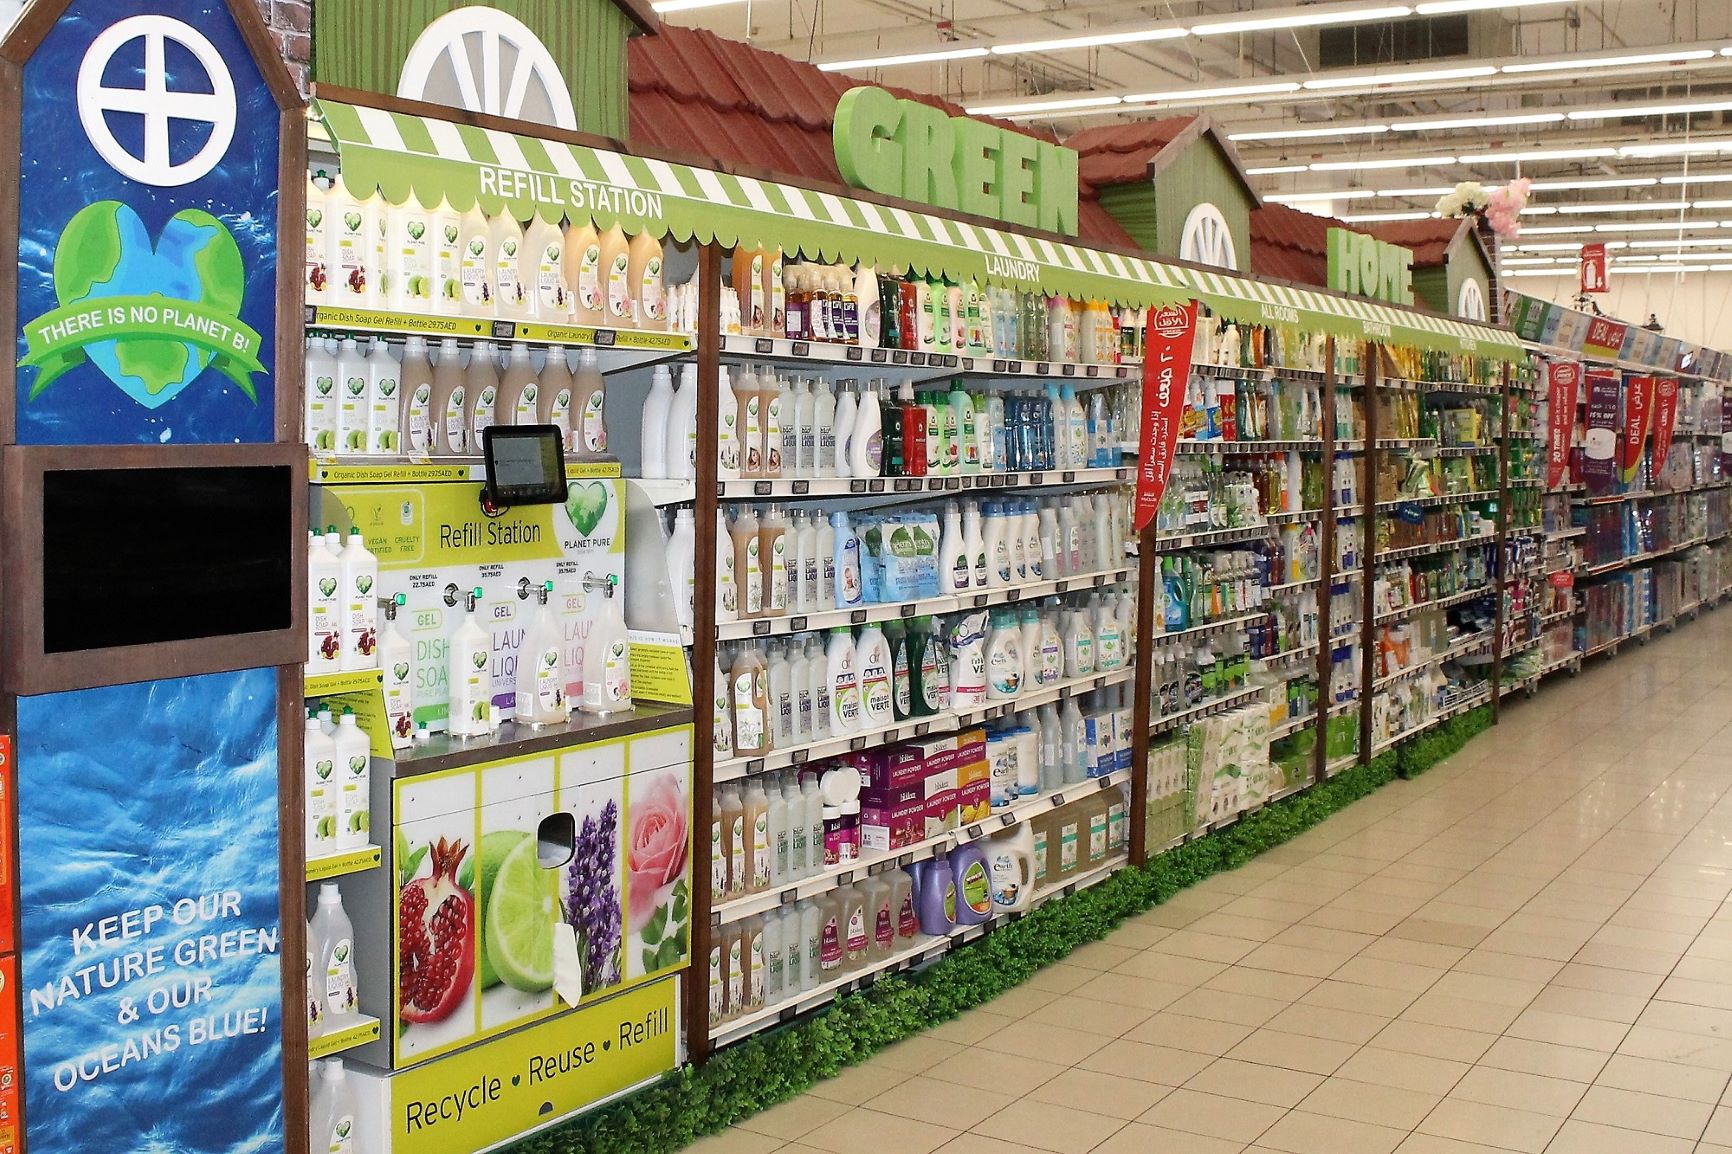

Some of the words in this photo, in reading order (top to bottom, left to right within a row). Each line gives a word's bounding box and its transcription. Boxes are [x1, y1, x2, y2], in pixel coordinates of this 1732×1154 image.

[833, 85, 1079, 237] GREEN
[480, 166, 565, 206] REFILL
[569, 180, 664, 220] STATION
[985, 255, 1041, 283] LAUNDRY
[1327, 227, 1415, 307] HOME
[316, 312, 338, 322] rganic
[339, 311, 354, 322] Dish
[355, 314, 372, 325] Soap
[373, 316, 384, 325] Gel
[385, 316, 402, 326] Refill
[408, 318, 428, 328] Bottle
[38, 310, 105, 345] THERE
[107, 306, 125, 325] IS
[130, 306, 158, 324] NO
[163, 308, 231, 342] PLANET
[231, 332, 250, 353] B!
[547, 330, 568, 340] Organic
[568, 331, 591, 342] Laundry
[1155, 368, 1173, 408] ضعف
[1630, 415, 1641, 445] DEAL
[334, 471, 356, 481] Organic
[356, 471, 369, 479] Dish
[369, 471, 383, 481] Soap
[384, 470, 393, 478] Gel
[412, 470, 428, 478] Bottle
[394, 536, 420, 544] CRUELTY
[440, 522, 483, 549] Refill
[487, 520, 541, 546] Station
[564, 539, 591, 550] PLANET
[592, 537, 611, 548] PURE
[494, 606, 511, 618] GEL
[566, 598, 582, 609] GEL
[417, 613, 437, 626] GEL
[416, 666, 449, 689] SOA
[842, 701, 858, 711] maiso
[871, 701, 890, 711] VERTE
[926, 758, 941, 768] LAUNDRY
[940, 753, 955, 763] POWDER
[961, 786, 976, 796] LAUNDRY
[975, 782, 990, 792] POWDER
[926, 799, 943, 809] LAUNDRY
[942, 793, 957, 804] POWDER
[892, 809, 909, 819] LAUNDRY
[908, 804, 924, 815] POWDER
[993, 863, 1013, 872] earth
[72, 904, 164, 956] KEEP
[172, 890, 242, 927] OUR
[29, 944, 167, 1017] NATURE
[174, 927, 278, 969] GREEN
[116, 997, 139, 1025] &
[147, 975, 213, 1015] OUR
[53, 1024, 181, 1093] OCEANS
[189, 1007, 267, 1047] BLUE!
[405, 1075, 501, 1135] Recycle
[528, 1041, 596, 1086] Reuse
[619, 1006, 669, 1051] Refill
